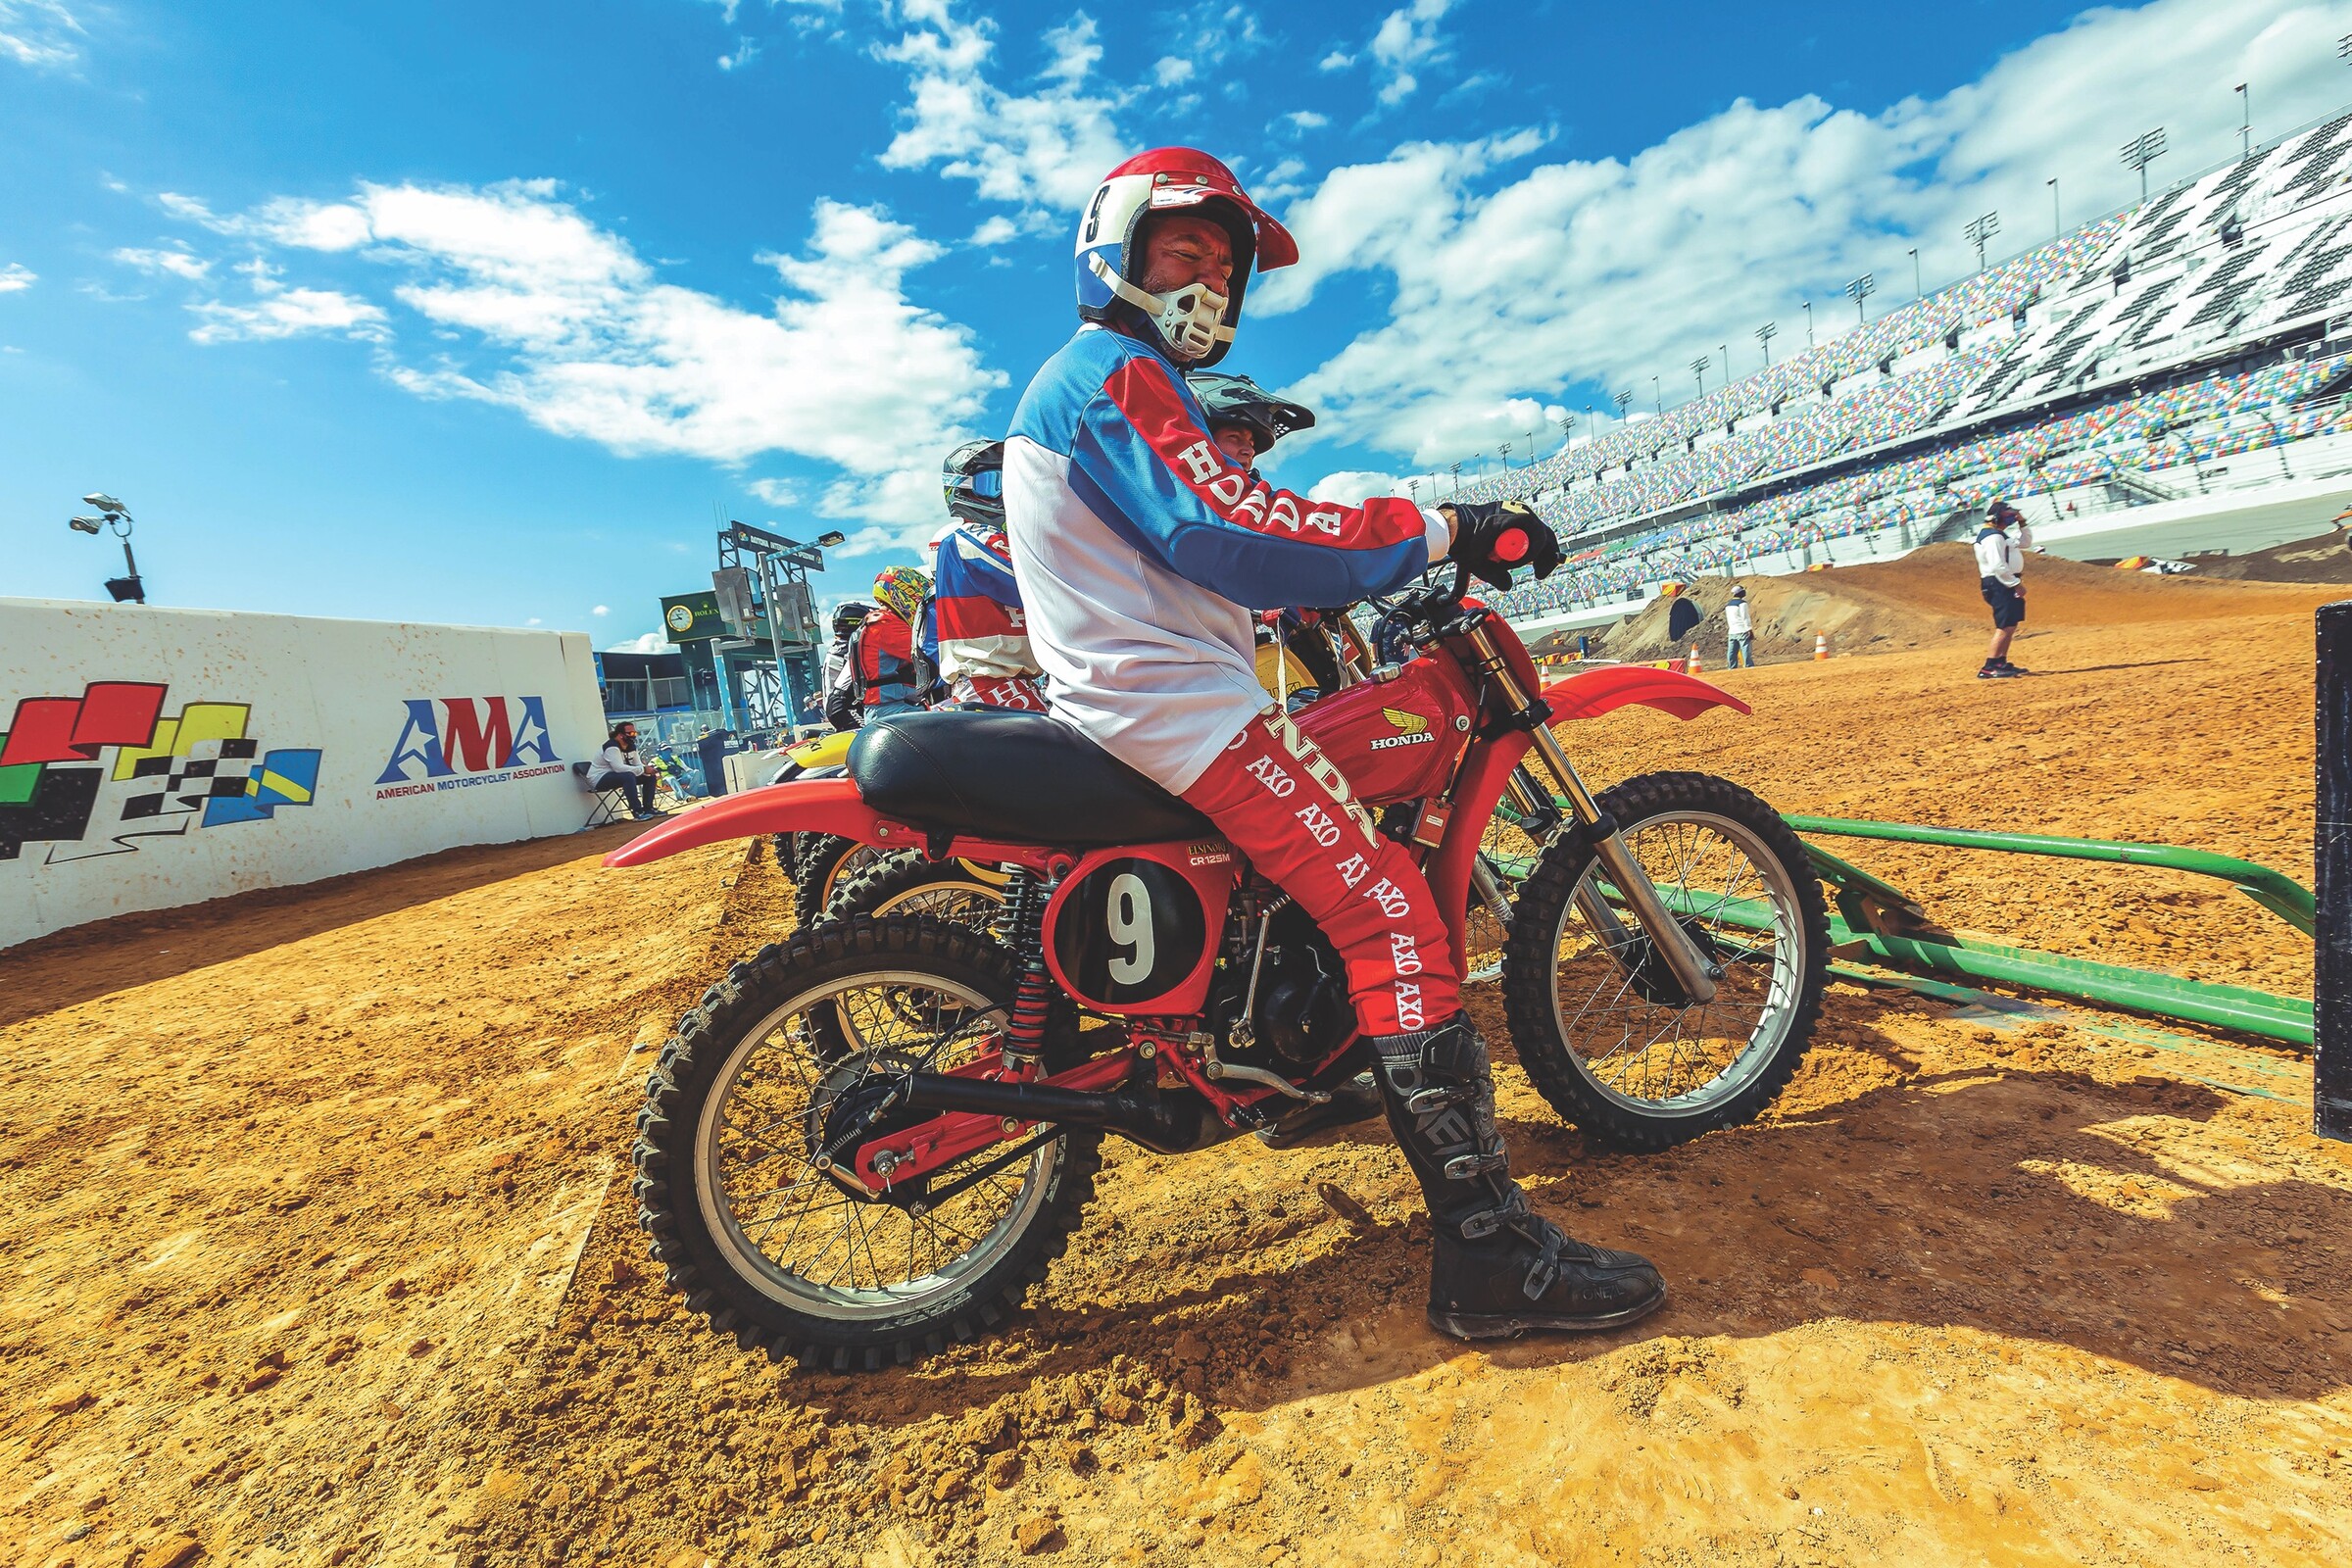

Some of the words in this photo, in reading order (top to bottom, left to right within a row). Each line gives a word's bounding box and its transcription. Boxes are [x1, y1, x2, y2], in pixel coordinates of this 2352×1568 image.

[1085, 185, 1110, 243] 9
[1177, 440, 1341, 537] HONDA
[374, 696, 563, 784] AMA
[1370, 732, 1435, 751] HONDA
[376, 783, 435, 801] AMERICAN
[437, 773, 512, 791] MOTORCYCLIST
[513, 764, 565, 780] ASSOCIATION
[1246, 755, 1296, 798] AXO
[1295, 802, 1341, 848] AXO
[1336, 853, 1370, 889] AX
[1363, 877, 1410, 918] AXO
[1107, 873, 1154, 985] 9
[1391, 932, 1423, 976] AXO
[1395, 980, 1425, 1031] AXO
